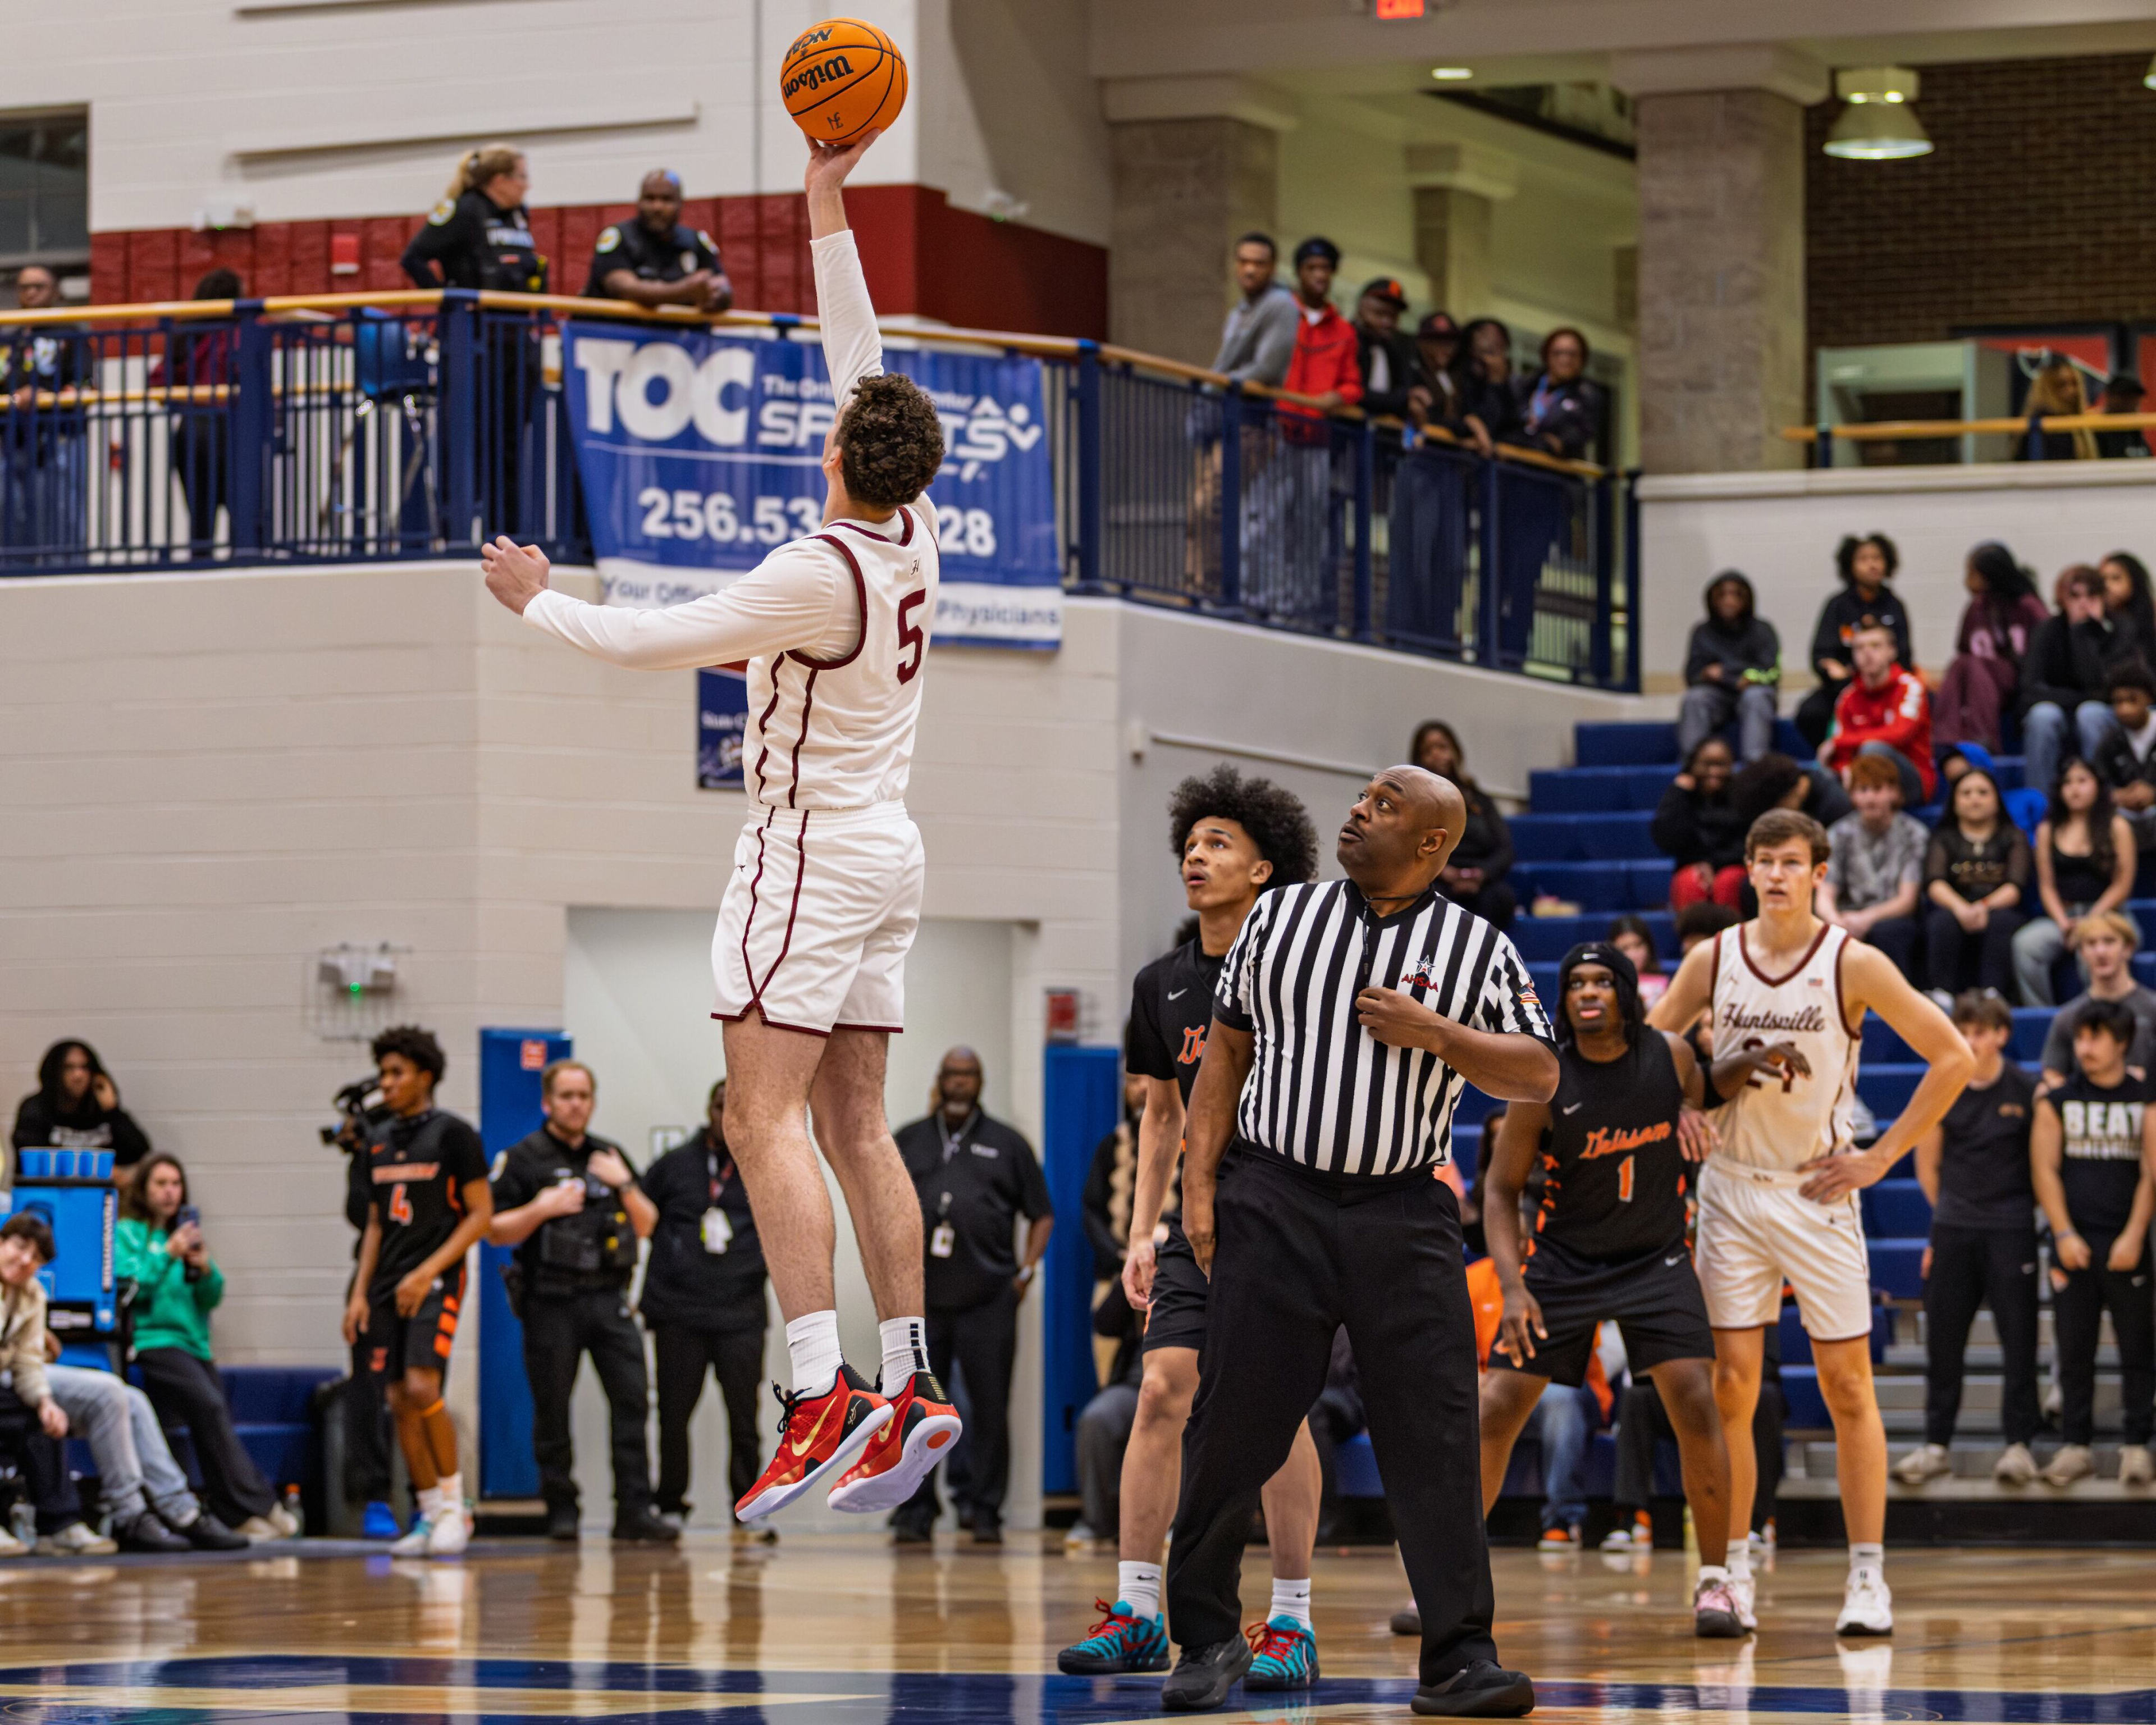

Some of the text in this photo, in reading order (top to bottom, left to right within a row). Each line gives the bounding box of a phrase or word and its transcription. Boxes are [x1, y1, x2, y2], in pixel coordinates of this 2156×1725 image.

[783, 55, 854, 99] Wilson
[574, 337, 755, 447] TOC
[757, 400, 1008, 462] SPTS
[897, 588, 926, 685] 5
[1400, 974, 1438, 993] AHSAA
[1723, 1003, 1825, 1032] Huntsville
[1618, 1154, 1635, 1203] 1
[389, 1183, 414, 1226] 4
